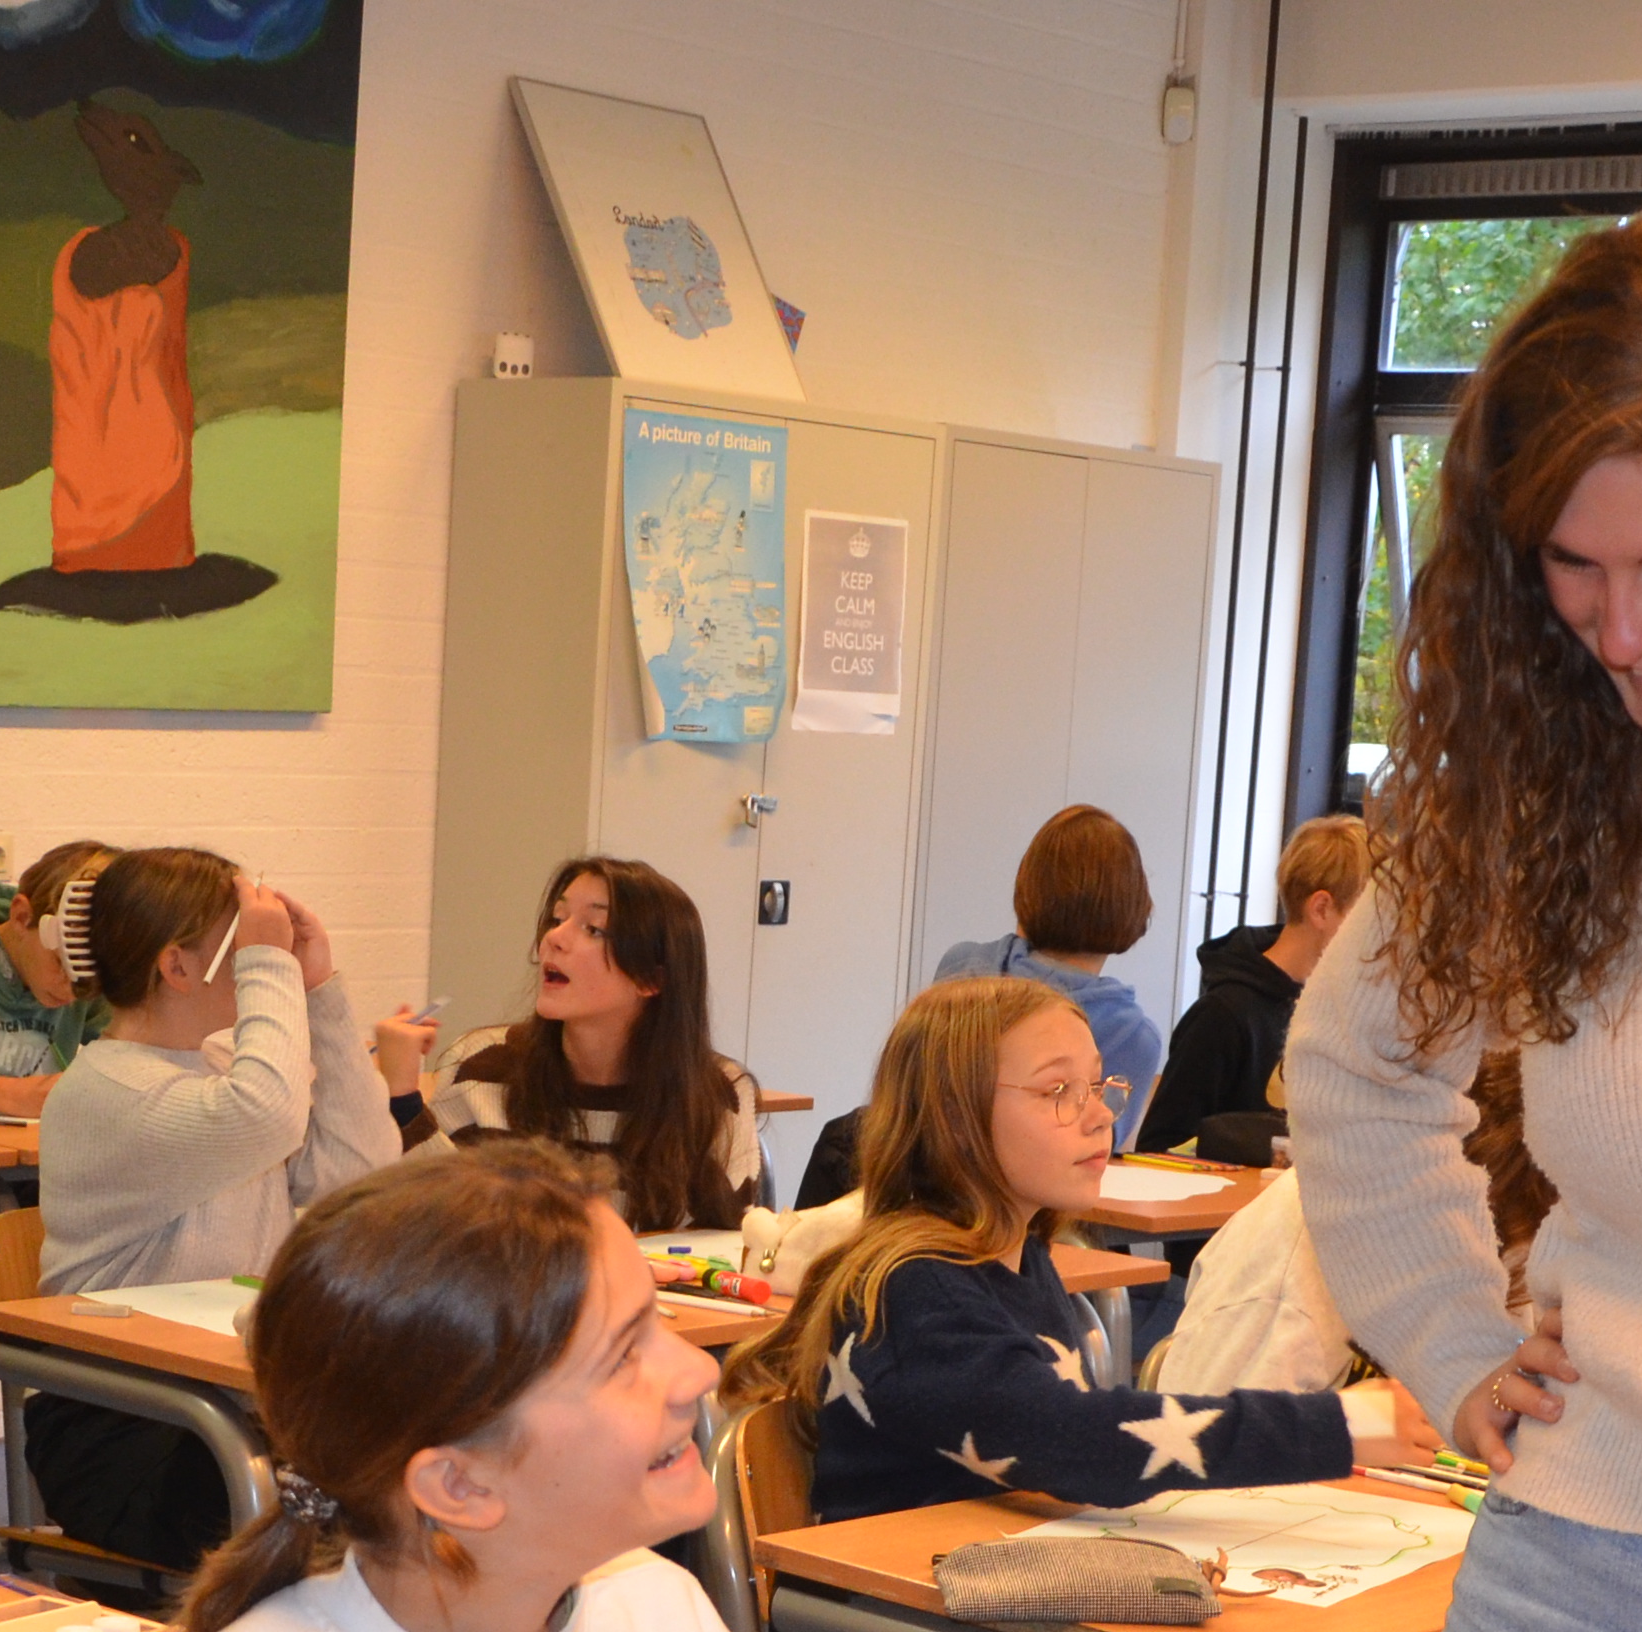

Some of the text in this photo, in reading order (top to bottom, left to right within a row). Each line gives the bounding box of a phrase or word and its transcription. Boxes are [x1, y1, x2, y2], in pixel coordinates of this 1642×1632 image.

[639, 421, 772, 453] A picture of Britain
[840, 571, 873, 591] KEEP
[836, 595, 875, 616] CALM
[823, 630, 884, 651] ENGLISH
[831, 656, 874, 676] CLASS
